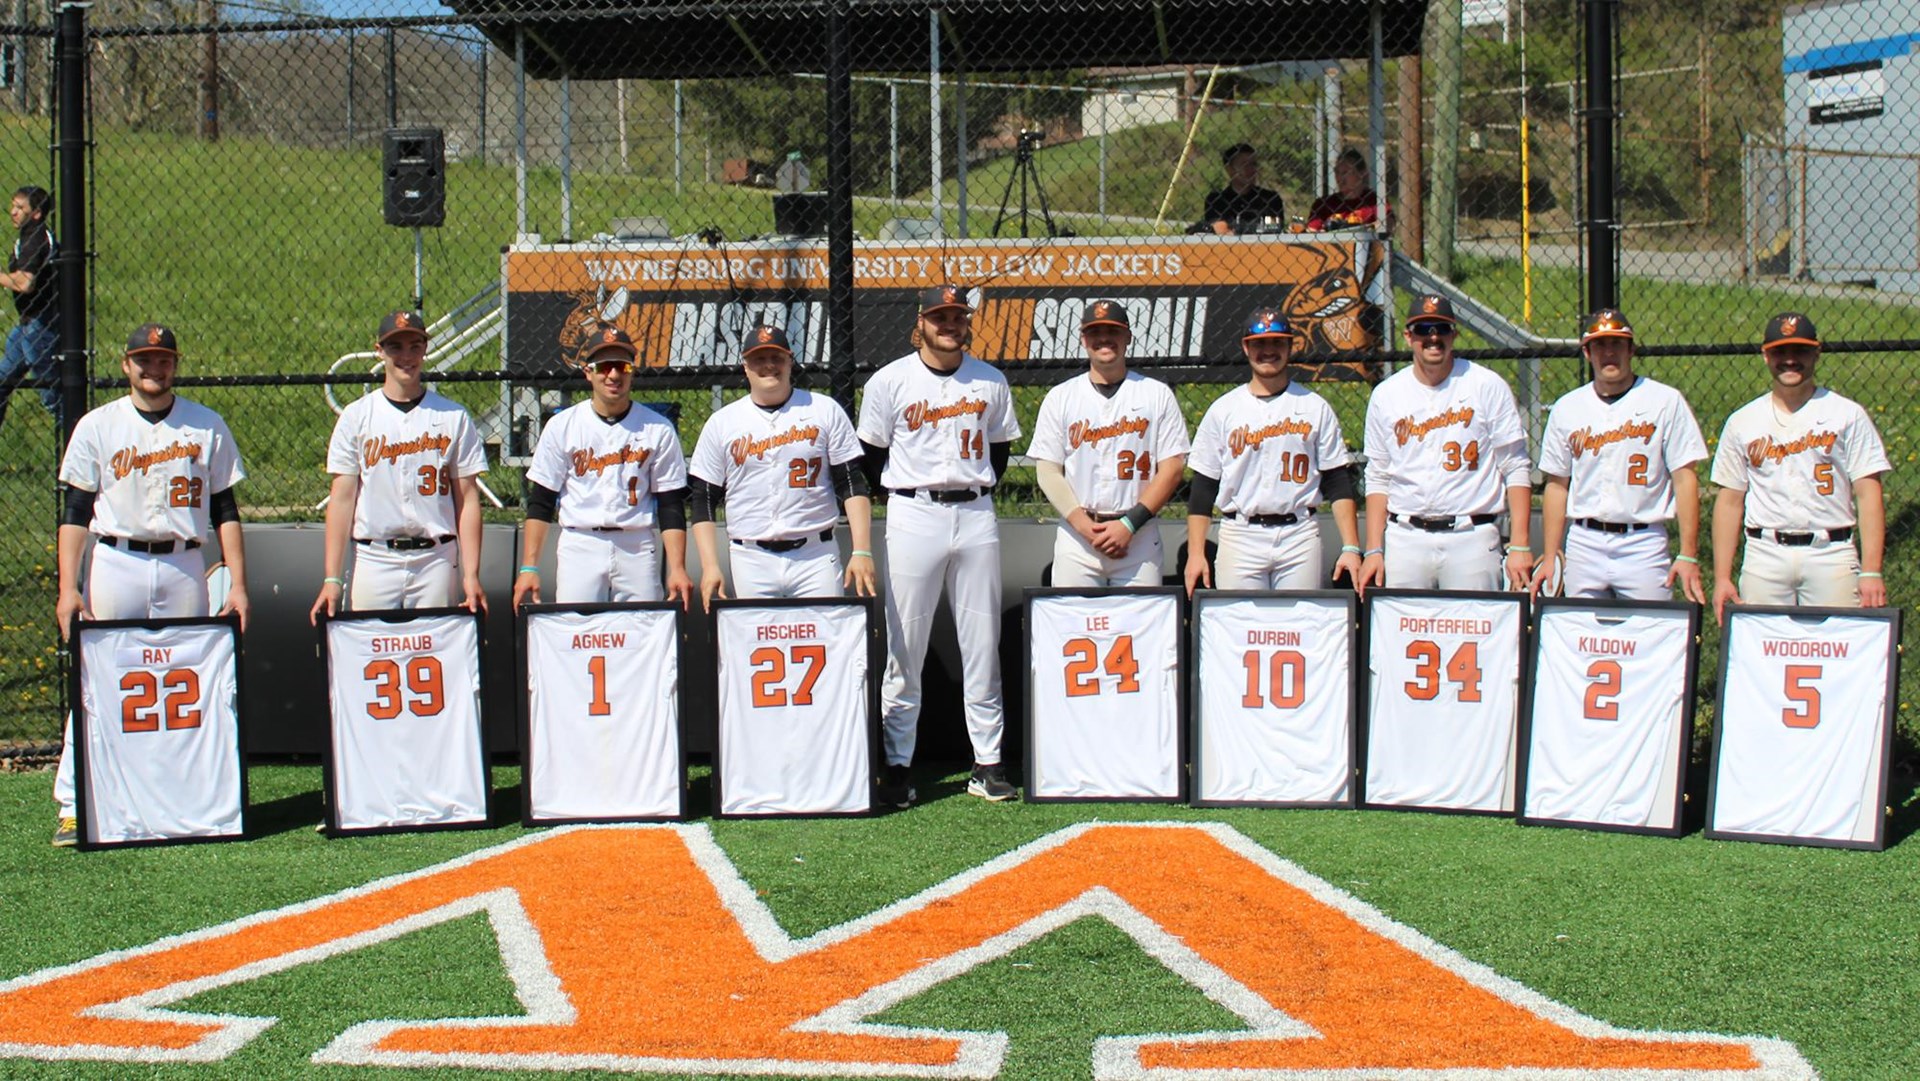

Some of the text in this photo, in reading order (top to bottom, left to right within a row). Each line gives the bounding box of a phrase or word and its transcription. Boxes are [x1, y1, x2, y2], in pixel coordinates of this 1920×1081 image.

[585, 253, 1183, 281] WAYNESBURG UNIVRSITY YELLOW JACKETS
[1029, 297, 1208, 358] SOBALL
[960, 429, 984, 460] 14
[1442, 440, 1480, 472] 34
[417, 464, 450, 496] 39
[788, 457, 822, 488] 27
[1117, 450, 1151, 481] 24
[1280, 451, 1310, 484] 10
[1627, 453, 1649, 486] 2
[1813, 463, 1835, 496] 5
[170, 476, 203, 508] 22
[627, 476, 638, 506] 1
[757, 623, 817, 640] FISCHER
[1086, 616, 1110, 632] LEE
[1247, 630, 1301, 647] DURBIN
[1399, 616, 1492, 635] PORTERFIELD
[142, 648, 173, 665] RAY
[371, 635, 433, 653] STRAUB
[571, 633, 626, 650] AGNEW
[1578, 636, 1637, 656] KILDOW
[1763, 640, 1850, 659] WOODROW
[750, 645, 827, 708] 27
[1062, 634, 1141, 698] 24
[1242, 649, 1306, 709] 10
[1404, 640, 1483, 703] 34
[119, 668, 202, 733] 22
[364, 655, 445, 720] 39
[588, 655, 612, 716] 1
[1583, 660, 1623, 721] 2
[1781, 664, 1823, 729] 5
